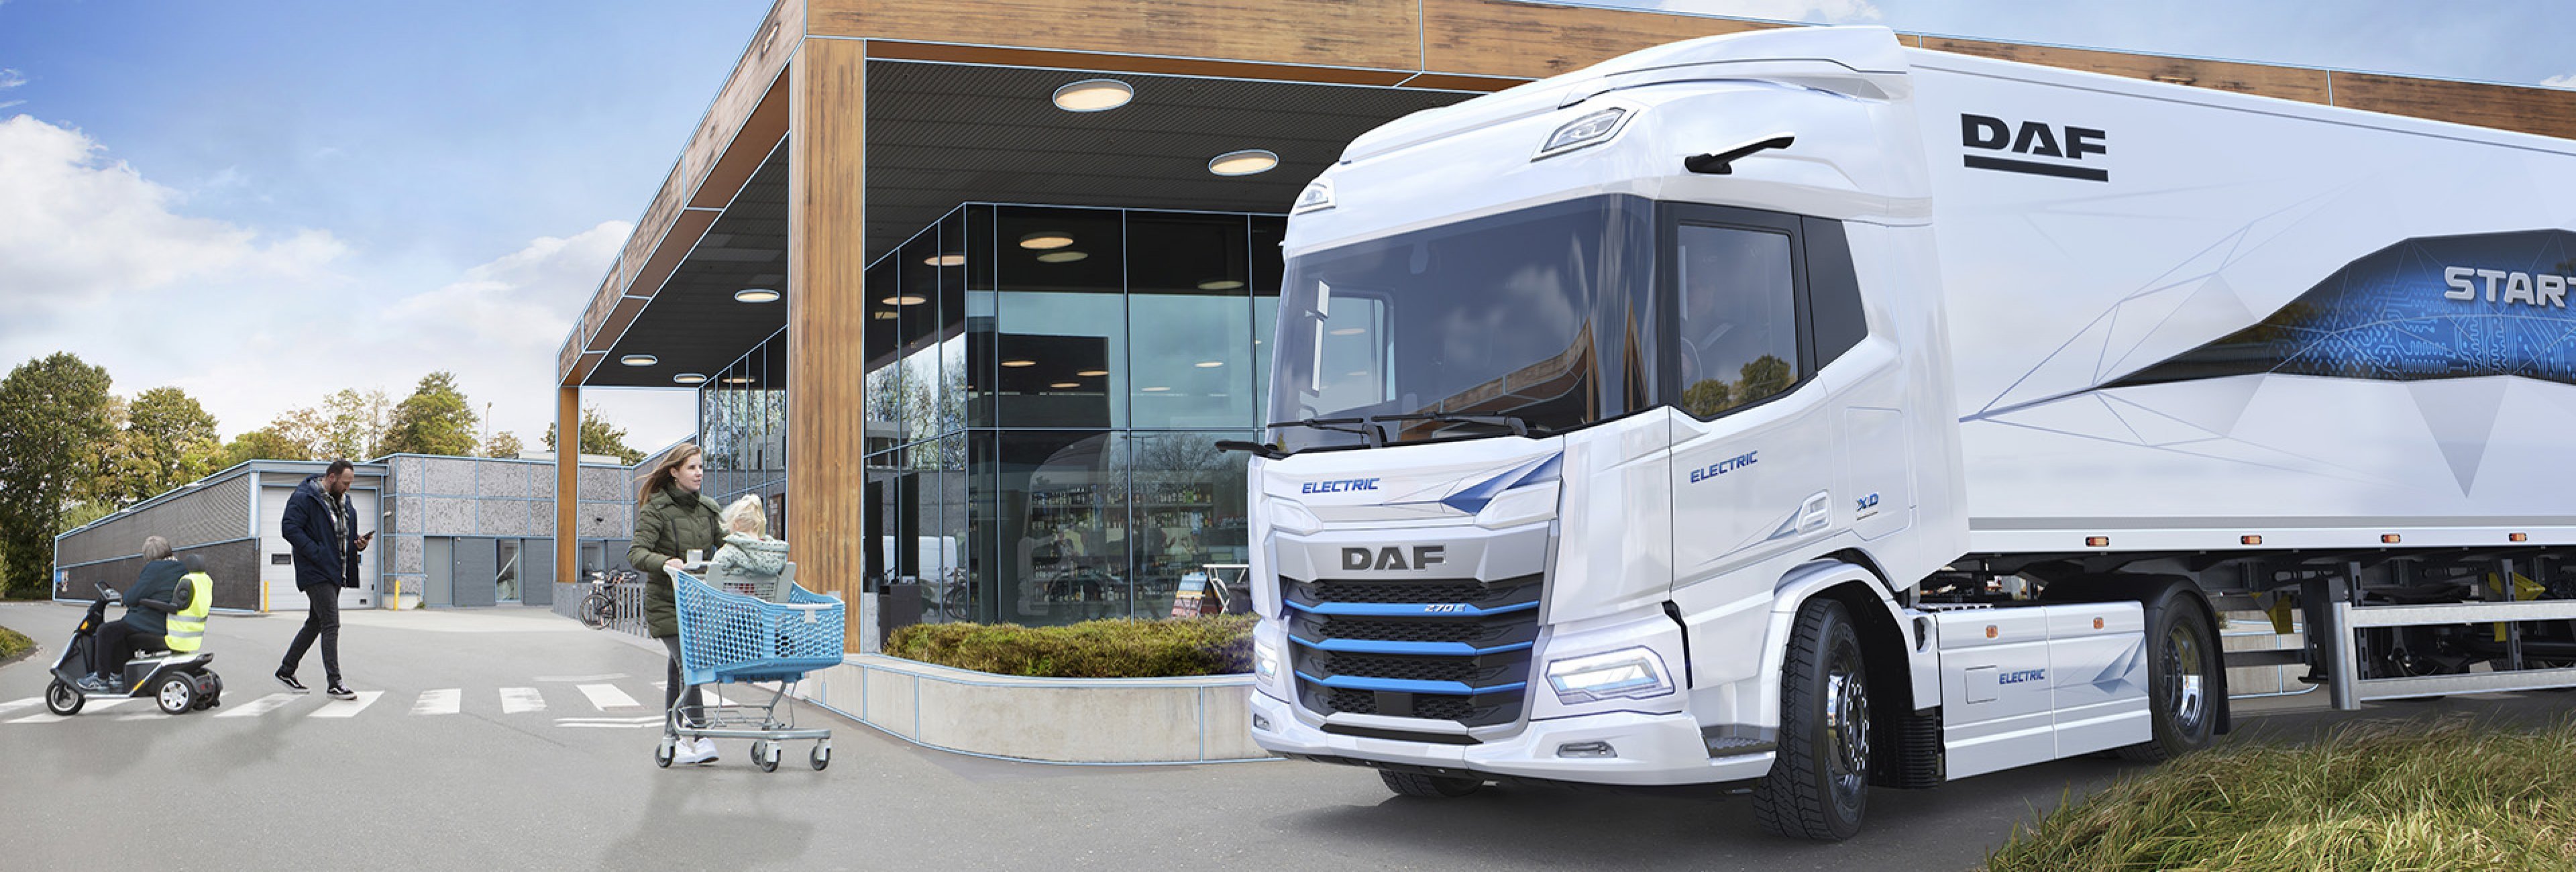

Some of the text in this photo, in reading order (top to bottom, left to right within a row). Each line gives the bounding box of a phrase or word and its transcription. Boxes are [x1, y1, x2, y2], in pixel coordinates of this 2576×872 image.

[1961, 113, 2106, 160] DAF
[2444, 266, 2576, 307] STAR
[1690, 450, 1758, 483] ELECTRIC
[1301, 478, 1381, 494] ELECTRIC
[1342, 545, 1444, 570] DAF
[1999, 669, 2045, 684] ELECTRIC
